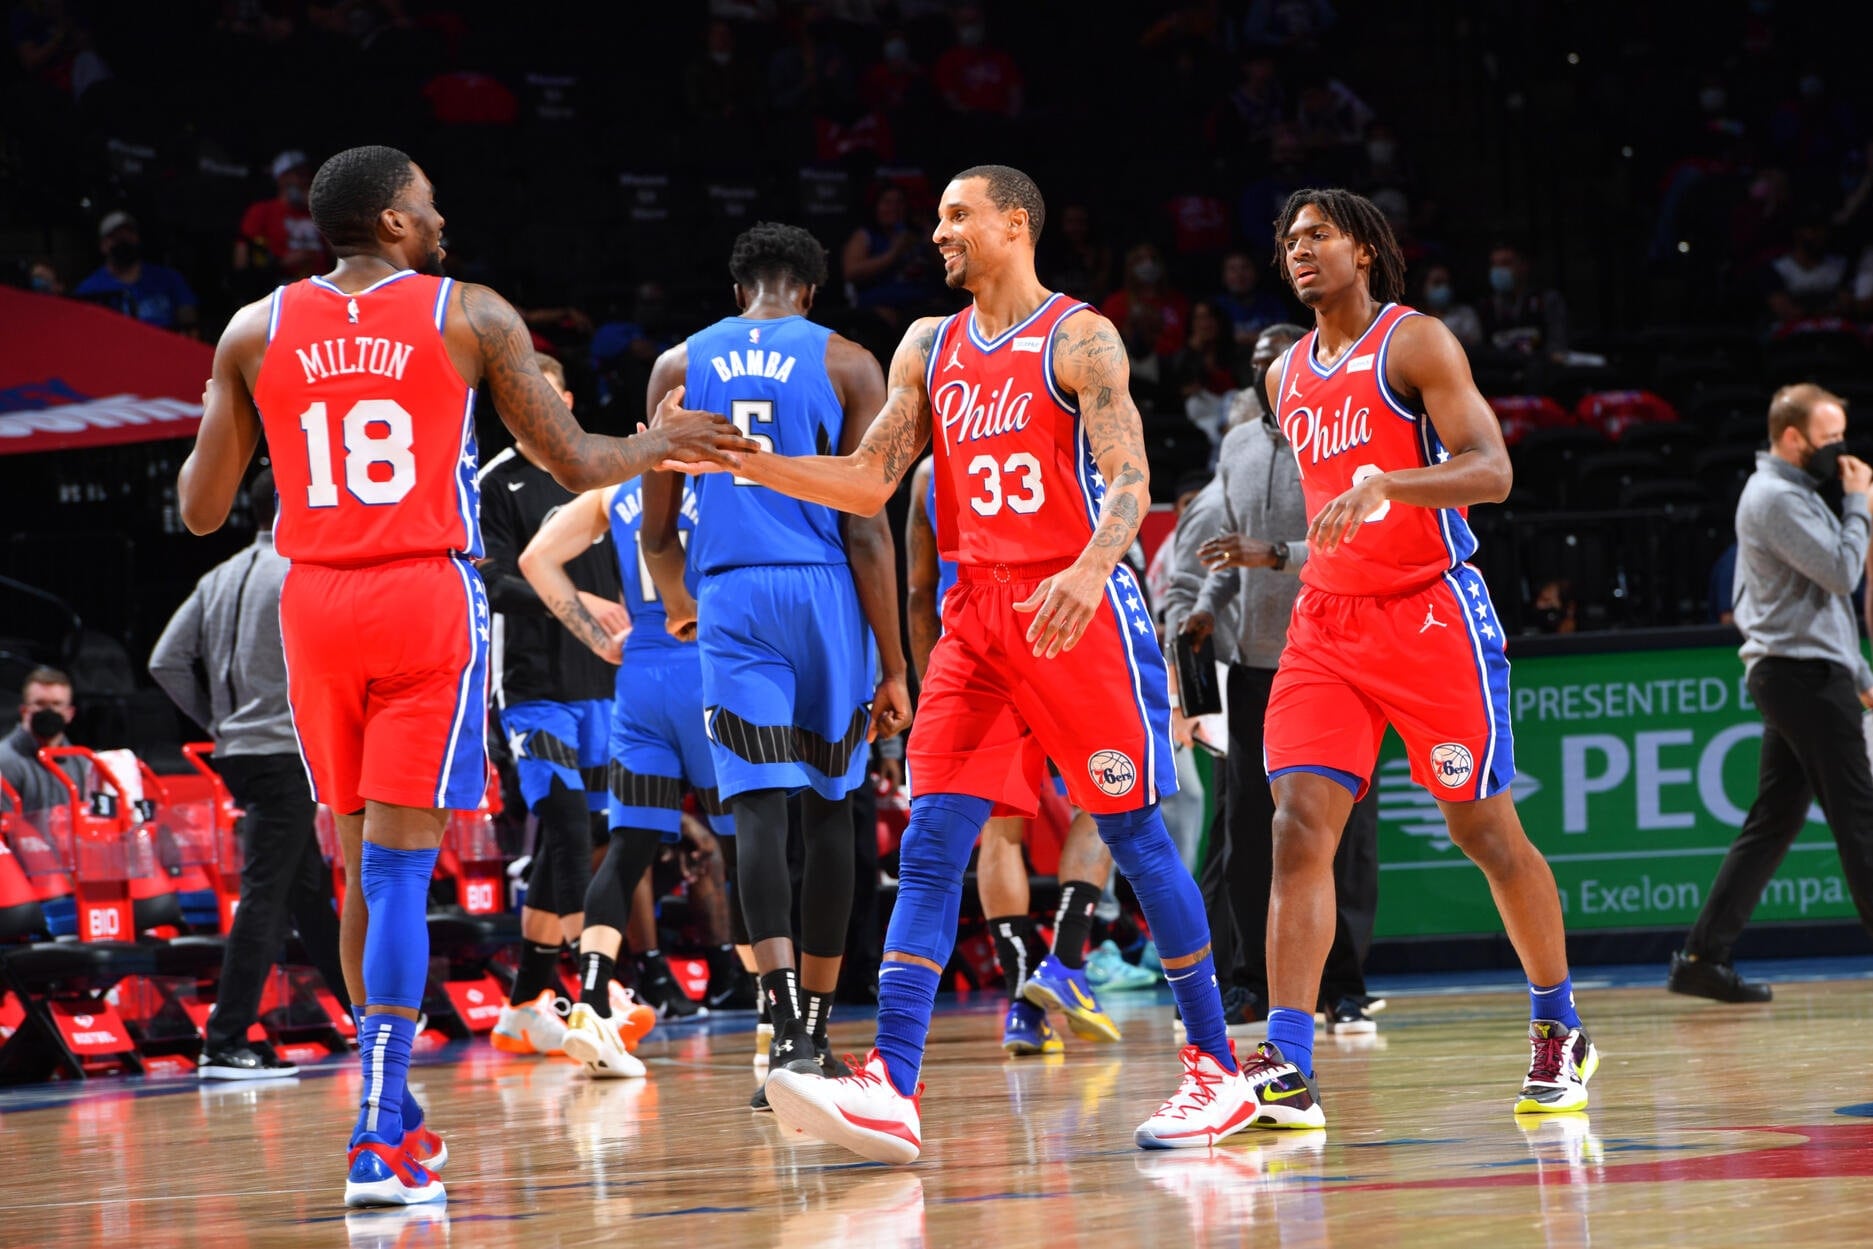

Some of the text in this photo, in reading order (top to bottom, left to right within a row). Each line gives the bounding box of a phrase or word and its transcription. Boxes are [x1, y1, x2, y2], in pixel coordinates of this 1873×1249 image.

[296, 337, 414, 384] MILTON
[711, 349, 797, 384] BAMBA
[934, 377, 1033, 457] Phila
[1284, 396, 1373, 480] Phila
[299, 399, 416, 508] 18
[968, 452, 1045, 516] 33
[1515, 677, 1728, 722] PRESENTED
[1094, 768, 1133, 785] 76ers
[1562, 722, 1828, 833] PEC
[1580, 874, 1699, 914] Exelon
